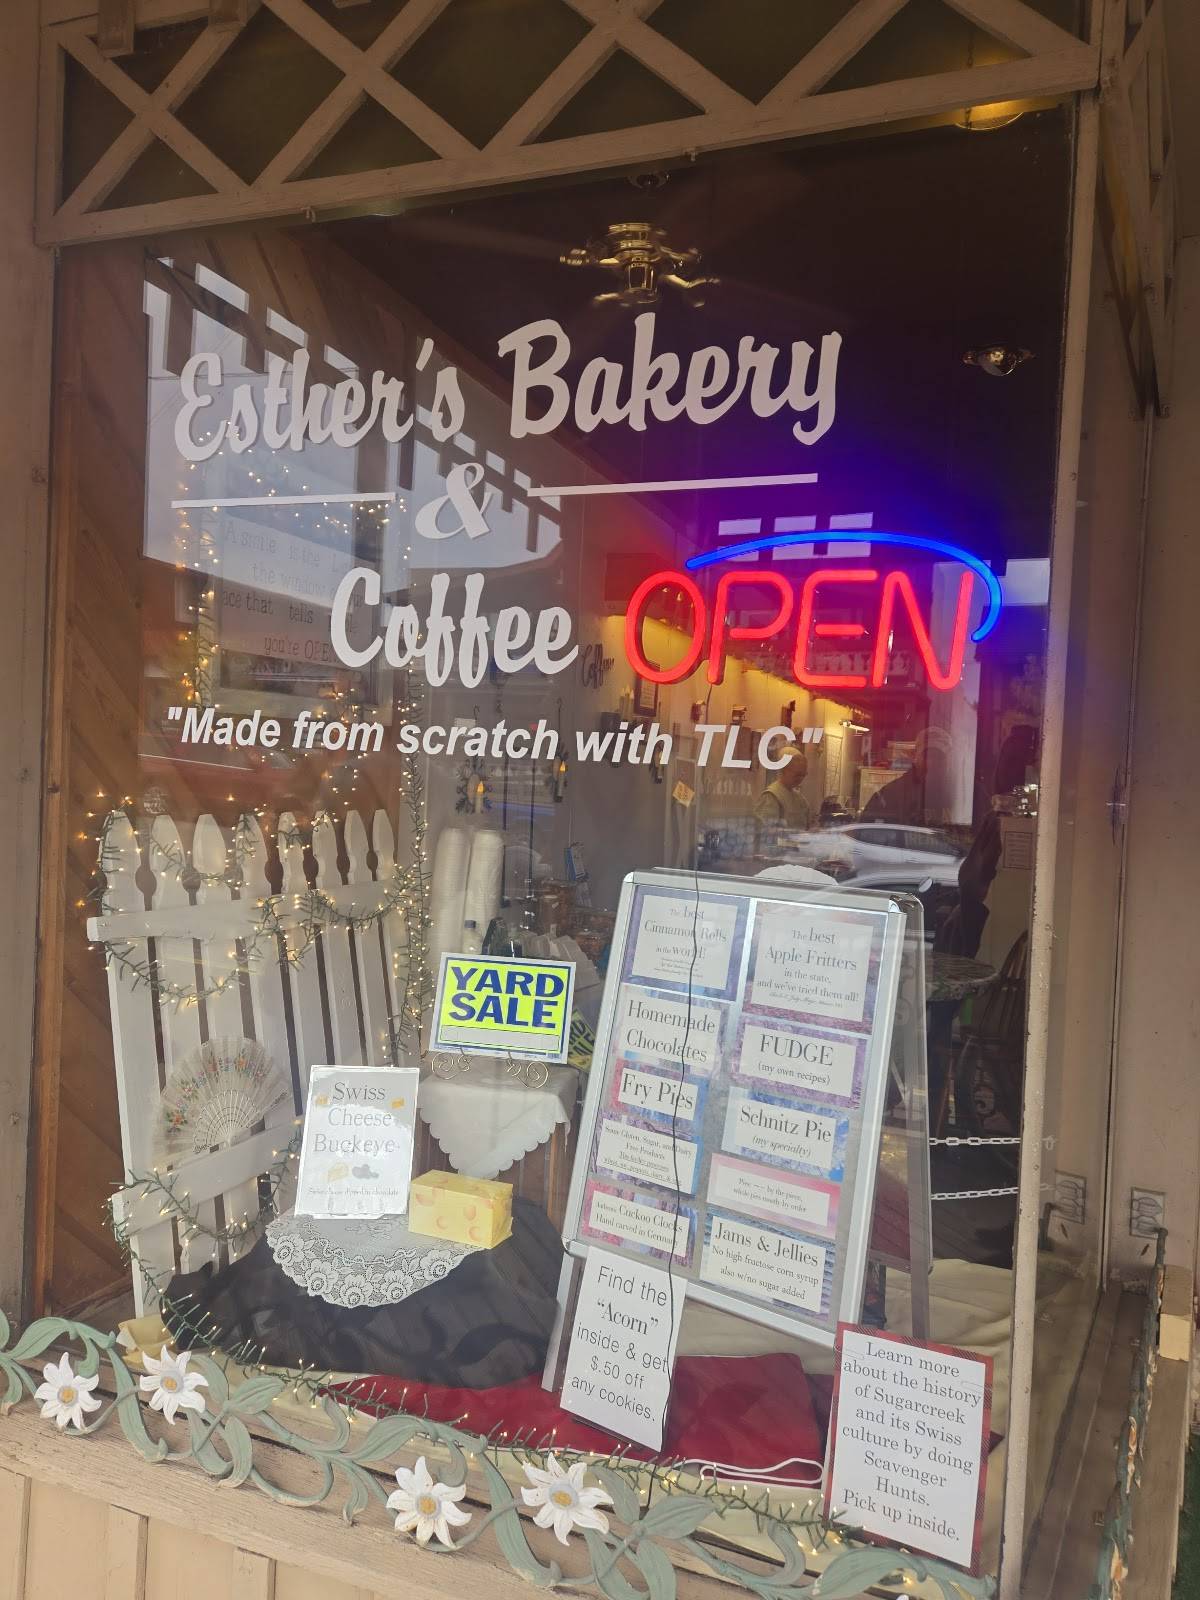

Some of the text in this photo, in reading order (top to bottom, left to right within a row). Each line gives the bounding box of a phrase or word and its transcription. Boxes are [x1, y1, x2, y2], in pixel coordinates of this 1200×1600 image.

[174, 312, 842, 461] Esther's Bakery
[415, 462, 494, 540] &
[246, 592, 273, 615] that
[330, 566, 580, 688] Coffee
[624, 571, 974, 690] OPEN
[167, 706, 824, 771] "Made from scratch with TLC"
[700, 927, 727, 942] Rolls
[792, 927, 836, 944] The best
[765, 944, 857, 971] Apple Fritters
[784, 967, 792, 977] in
[794, 969, 807, 979] the
[451, 966, 565, 998] YARD
[757, 979, 773, 989] and
[798, 984, 818, 995] tried
[820, 987, 843, 999] them
[449, 992, 558, 1029] SALE
[628, 999, 715, 1034] Homemade
[626, 1028, 708, 1062] Chocolates
[760, 1033, 834, 1066] FUDGE
[332, 1081, 387, 1101] Swiss
[758, 1061, 831, 1086] (my own recipes)
[622, 1073, 694, 1110] Fry Pies
[327, 1107, 392, 1127] Cheese
[740, 1104, 832, 1143] Schnitz Pie
[752, 1135, 812, 1158] (my specialty)
[596, 1213, 615, 1226] Hand
[615, 1219, 638, 1233] carved
[638, 1227, 646, 1236] in
[619, 1204, 651, 1222] Cuckoo
[715, 1222, 818, 1267] Jams & Jellies
[712, 1245, 819, 1288] No high fructose corn syrup
[720, 1266, 805, 1300] also w/no sugar added
[598, 1266, 667, 1306] Find the
[577, 1323, 668, 1373] inside & get
[867, 1342, 960, 1377] Learn more
[591, 1355, 645, 1389] $.50 off
[844, 1360, 981, 1407] about the history
[571, 1376, 655, 1421] any cookies.
[855, 1385, 965, 1424] of Sugarcreek
[856, 1407, 962, 1445] and its Swiss
[842, 1426, 973, 1475] culture by doing
[864, 1450, 947, 1488] Scavenger
[876, 1476, 930, 1506] Hunts.
[843, 1489, 960, 1541] Pick up inside.
